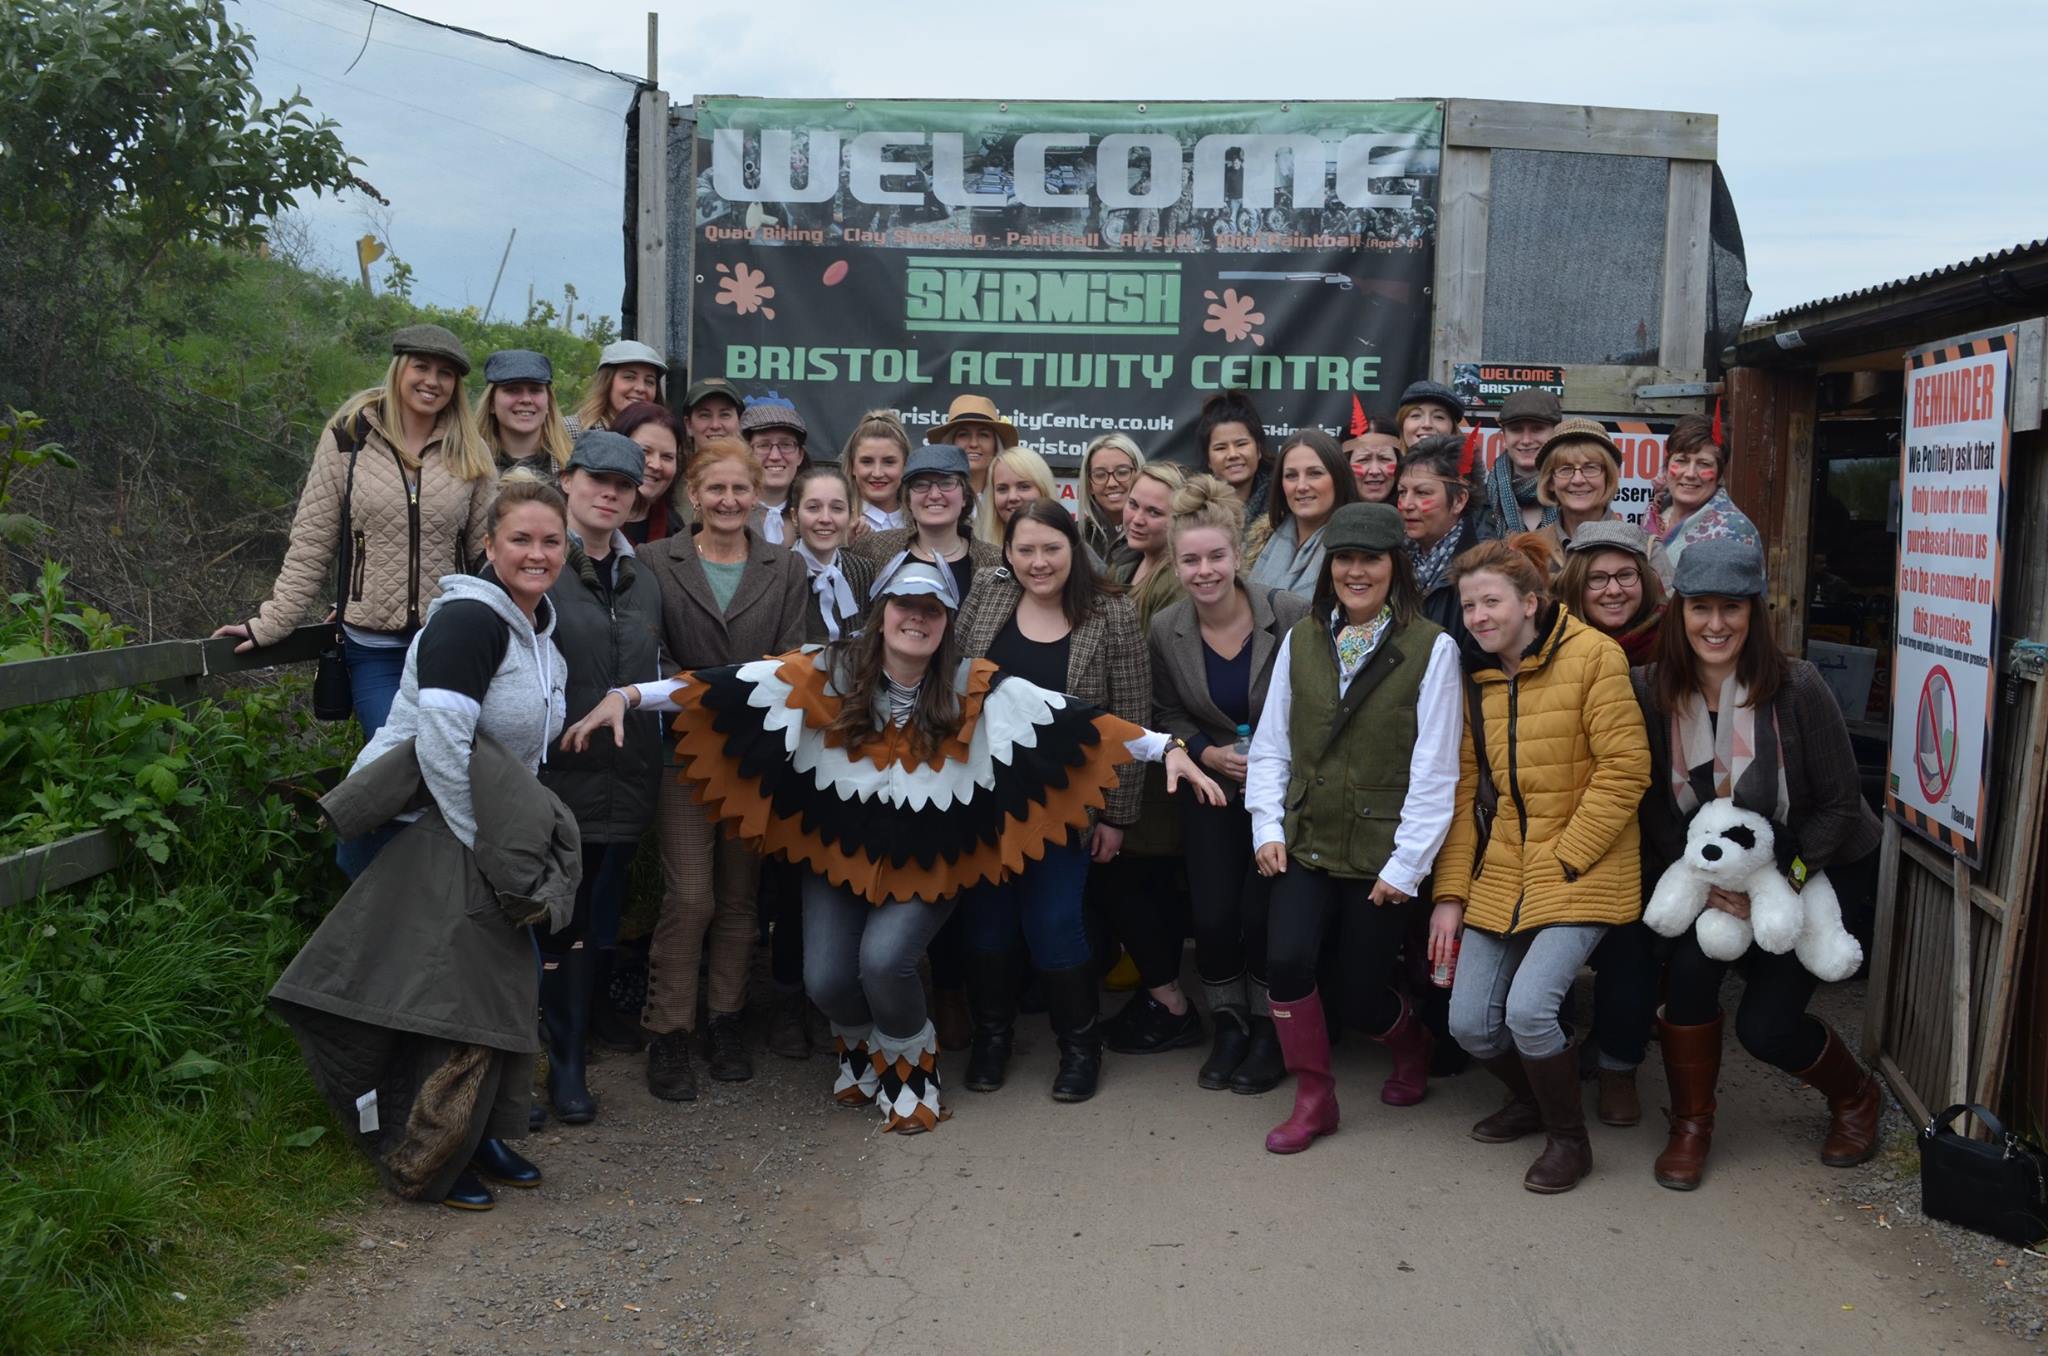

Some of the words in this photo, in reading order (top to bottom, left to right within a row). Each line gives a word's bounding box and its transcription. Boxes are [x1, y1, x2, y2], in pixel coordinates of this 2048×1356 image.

[713, 128, 1415, 209] WELCOME
[705, 225, 756, 242] Quad
[763, 225, 824, 243] Biking
[843, 227, 886, 245] Clay
[893, 229, 986, 248] Shooting
[1006, 228, 1099, 247] Paintball
[1268, 231, 1361, 248] Paintball
[726, 344, 933, 383] BRISTOL
[950, 350, 1174, 389] ACTIVITY
[1191, 355, 1381, 392] CENTRE
[1480, 367, 1554, 382] WELCOME
[1913, 364, 1995, 428] REMINDER
[1908, 446, 1921, 473] We
[1922, 443, 1953, 474] Politely
[1955, 441, 1972, 473] ask
[1974, 440, 1995, 471] that
[1911, 485, 1929, 516] Only
[1930, 484, 1949, 514] food
[1951, 489, 1961, 514] or
[1962, 484, 1988, 515] drink
[1907, 526, 1950, 555] purchased
[1951, 527, 1974, 558] from
[1975, 533, 1987, 560] us
[1901, 564, 1908, 592] is
[1909, 567, 1917, 593] to
[1918, 566, 1929, 595] be
[1930, 572, 1977, 603] consumed
[1978, 578, 1991, 605] on
[1913, 606, 1929, 636] this
[1929, 612, 1973, 647] premises.
[1951, 804, 1965, 826] Thank
[1964, 814, 1975, 831] you
